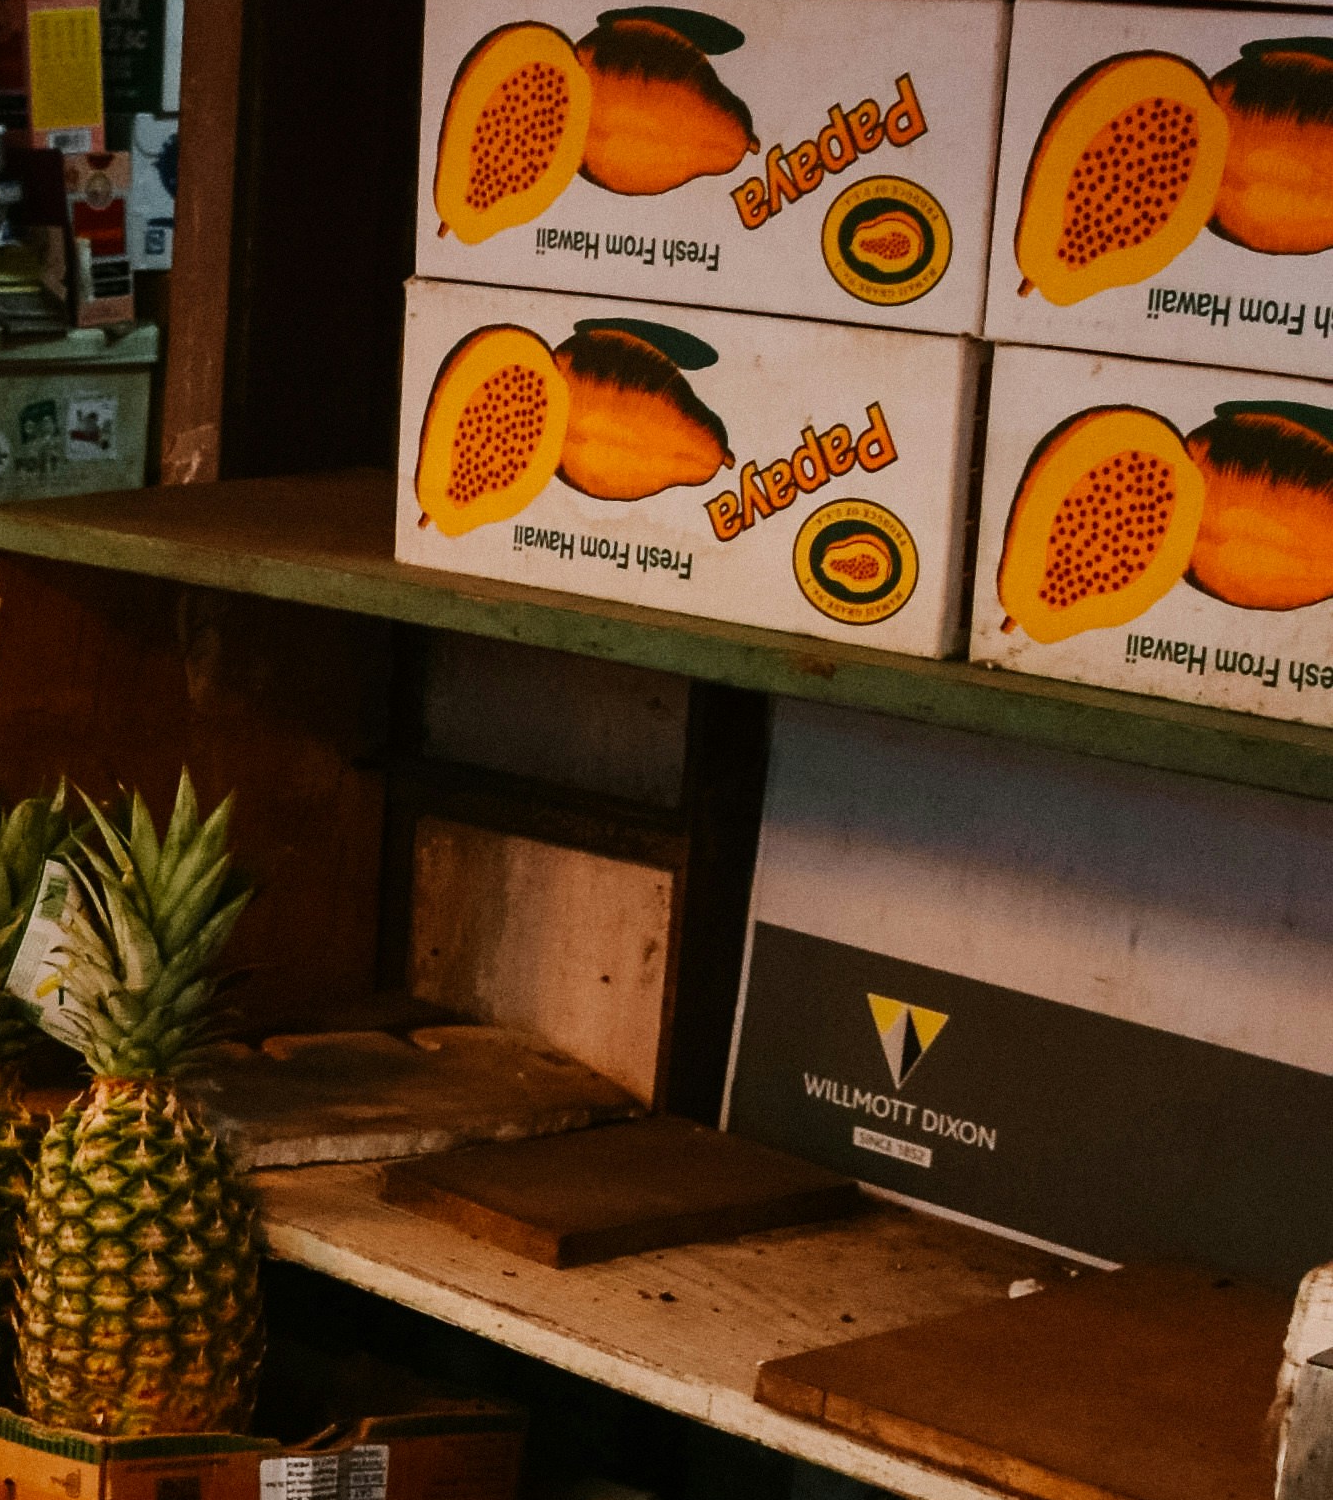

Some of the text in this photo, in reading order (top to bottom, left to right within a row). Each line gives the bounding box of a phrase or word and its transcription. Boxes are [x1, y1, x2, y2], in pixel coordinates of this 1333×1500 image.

[730, 72, 929, 232] Papaya
[535, 227, 721, 272] Fresh From Hawaii
[1145, 287, 1233, 328] Hawaii
[1238, 296, 1307, 336] From
[704, 400, 899, 543] Papaya
[512, 524, 694, 581] Fresh From Hawaii
[1125, 633, 1333, 693] Hawaii From esh
[803, 1071, 998, 1152] WILLMOTT DIXON
